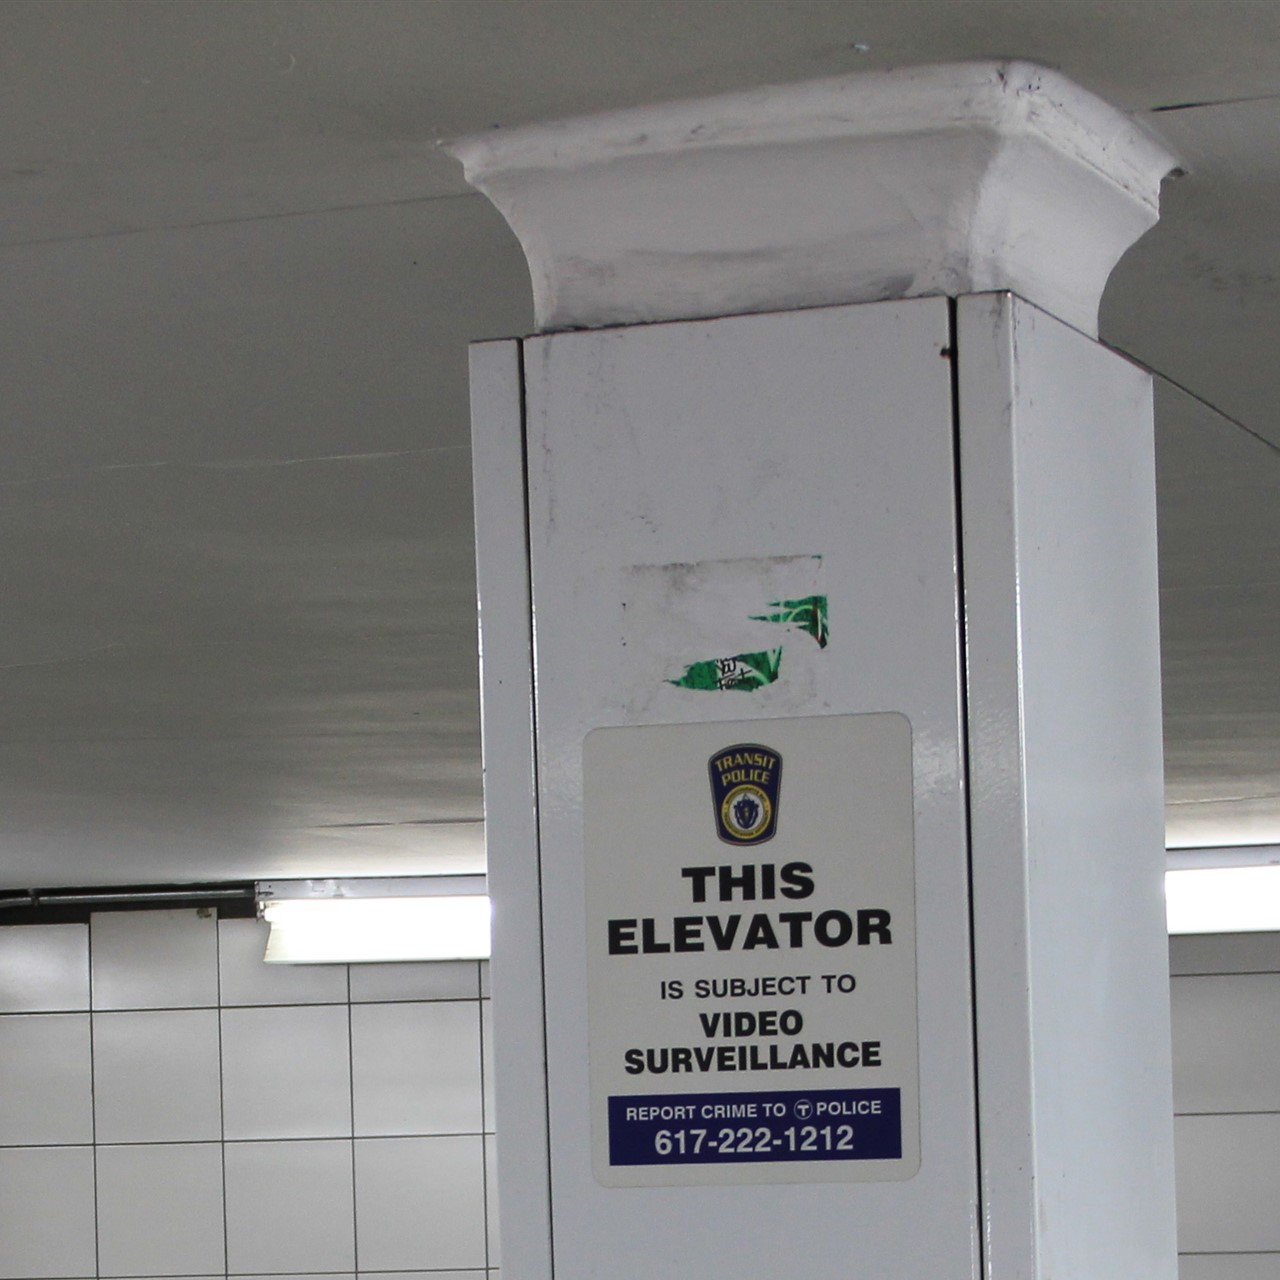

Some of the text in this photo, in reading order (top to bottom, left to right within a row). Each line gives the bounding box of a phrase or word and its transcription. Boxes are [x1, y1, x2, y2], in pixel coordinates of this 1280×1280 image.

[714, 753, 776, 772] TRANSIT
[721, 769, 770, 787] POLICE
[681, 861, 815, 903] THIS
[607, 908, 893, 956] ELEVATOR
[660, 974, 857, 1000] IS SUBJECT TO
[698, 1009, 804, 1039] VIDEO
[624, 1040, 882, 1075] SURVEILLANCE
[626, 1105, 696, 1121] REPORT
[701, 1103, 758, 1119] CRIME
[762, 1102, 786, 1118] TO
[816, 1100, 882, 1116] POLICE
[654, 1124, 854, 1155] 617-222-1212
